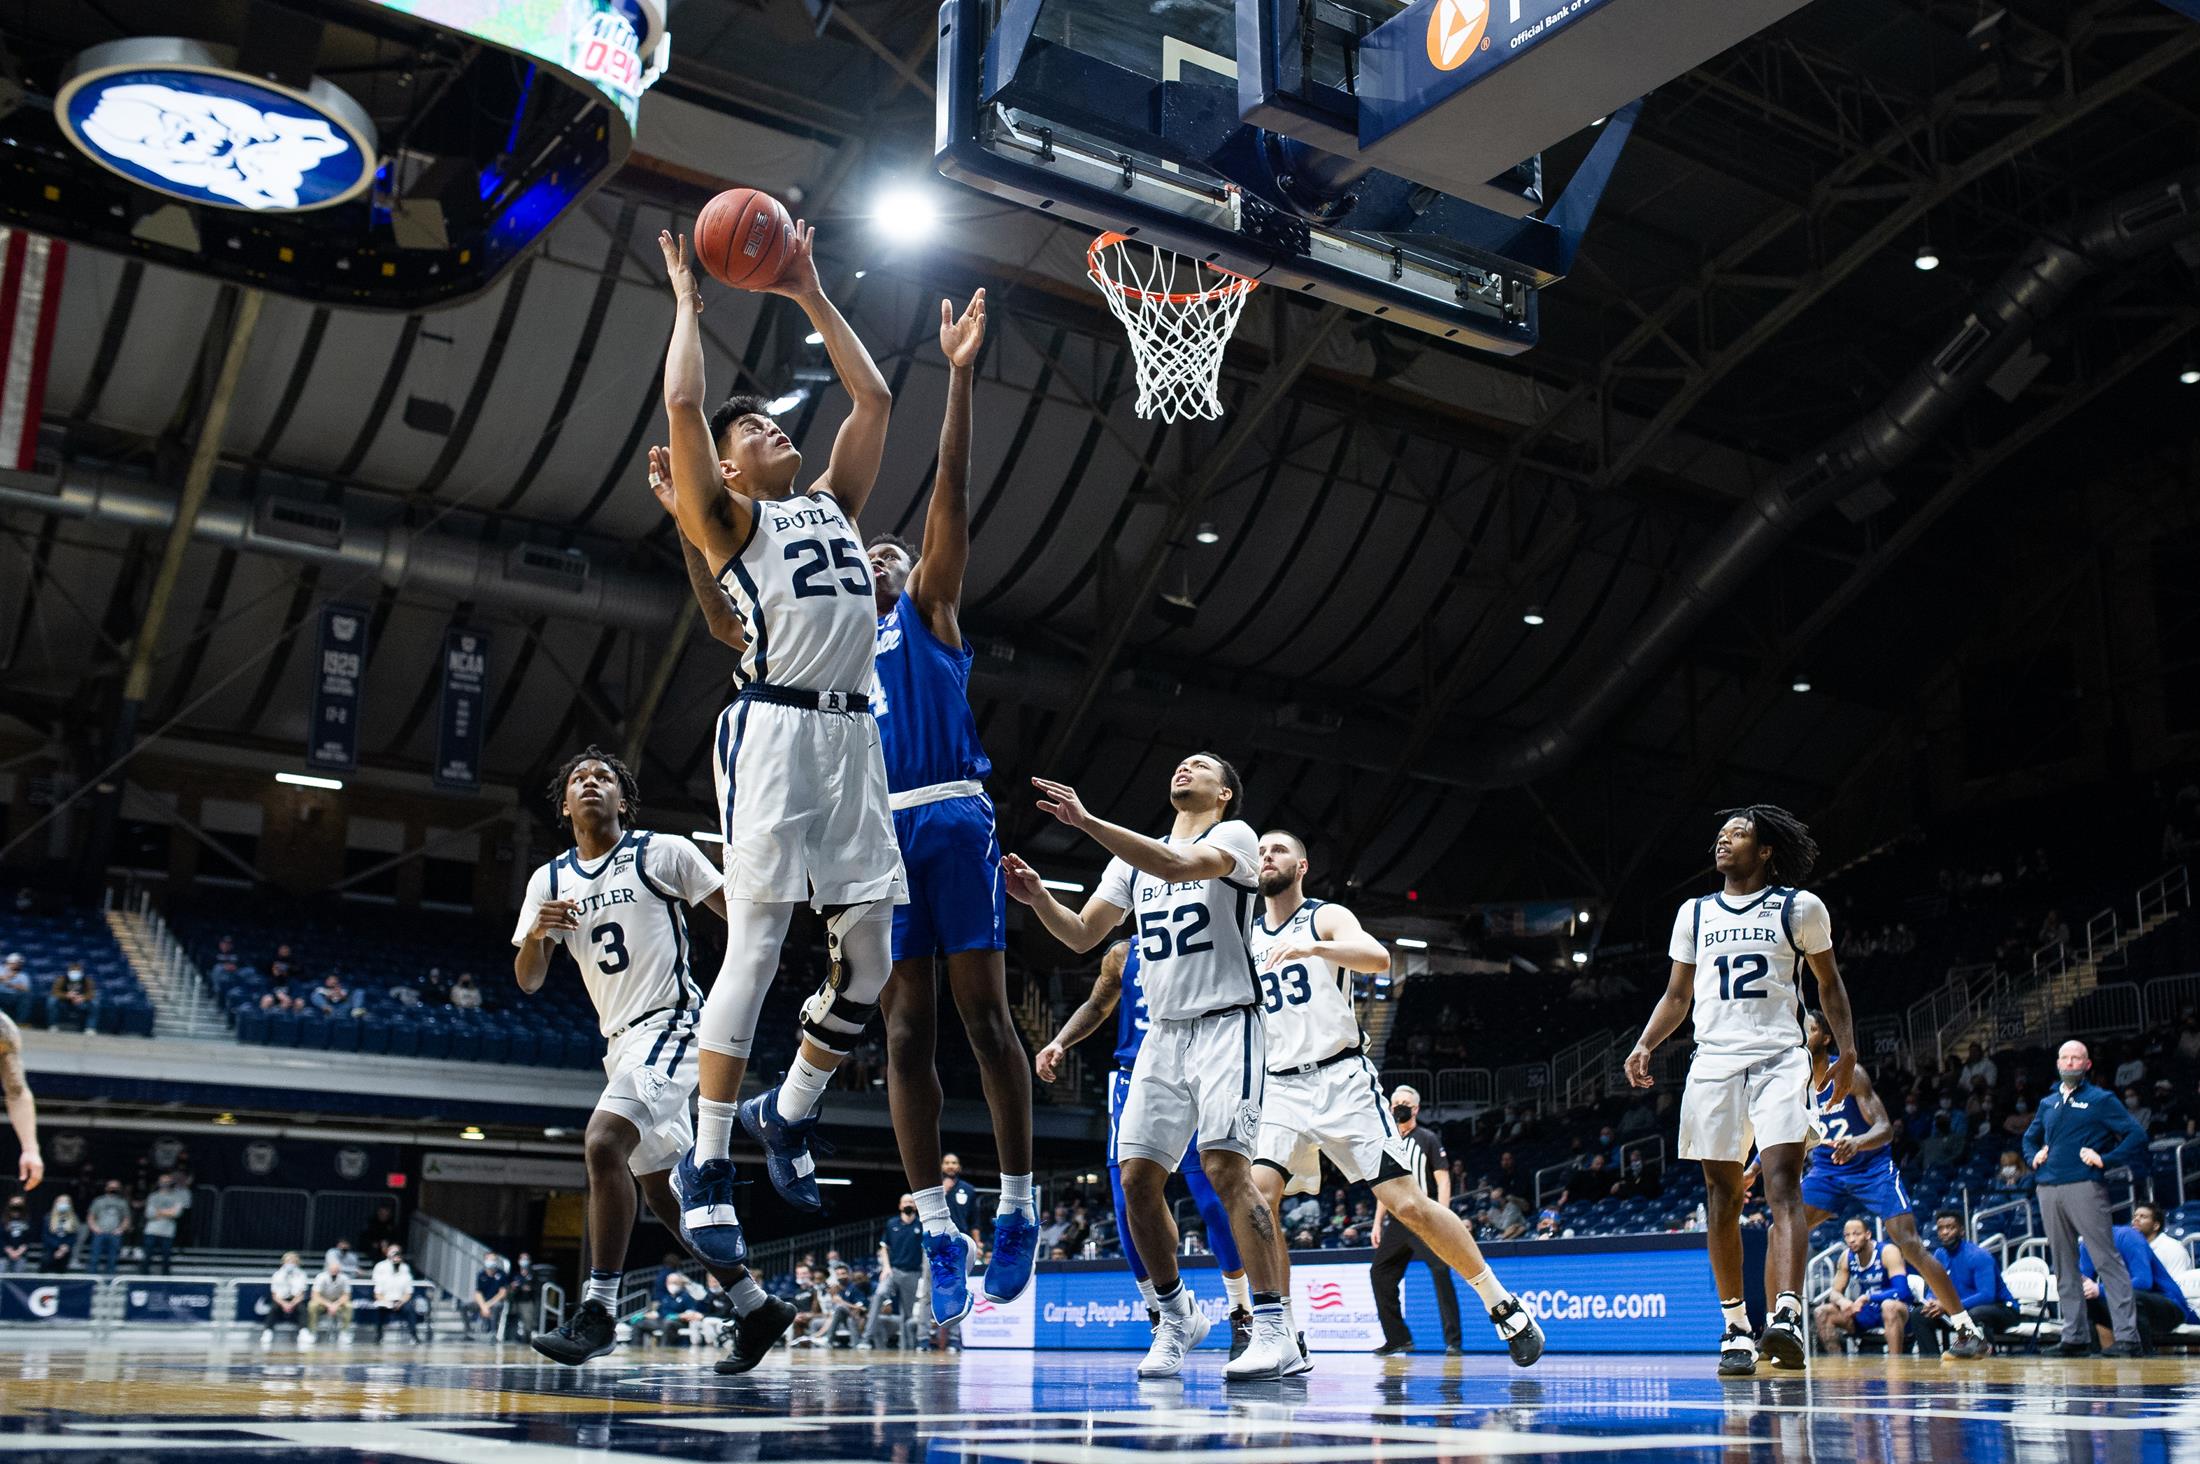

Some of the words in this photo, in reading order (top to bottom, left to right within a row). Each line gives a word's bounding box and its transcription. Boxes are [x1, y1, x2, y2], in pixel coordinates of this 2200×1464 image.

[1509, 20, 1544, 49] Official
[1545, 5, 1570, 28] Bank
[783, 537, 873, 600] 25
[591, 921, 631, 976] 3
[1139, 901, 1214, 962] 52
[1704, 927, 1778, 948] BUTLER
[1259, 963, 1312, 1015] 33
[1713, 953, 1770, 1001] 12
[1043, 1301, 1086, 1328] Caring
[1087, 1299, 1131, 1328] People
[1513, 1289, 1667, 1320] SCCare.com
